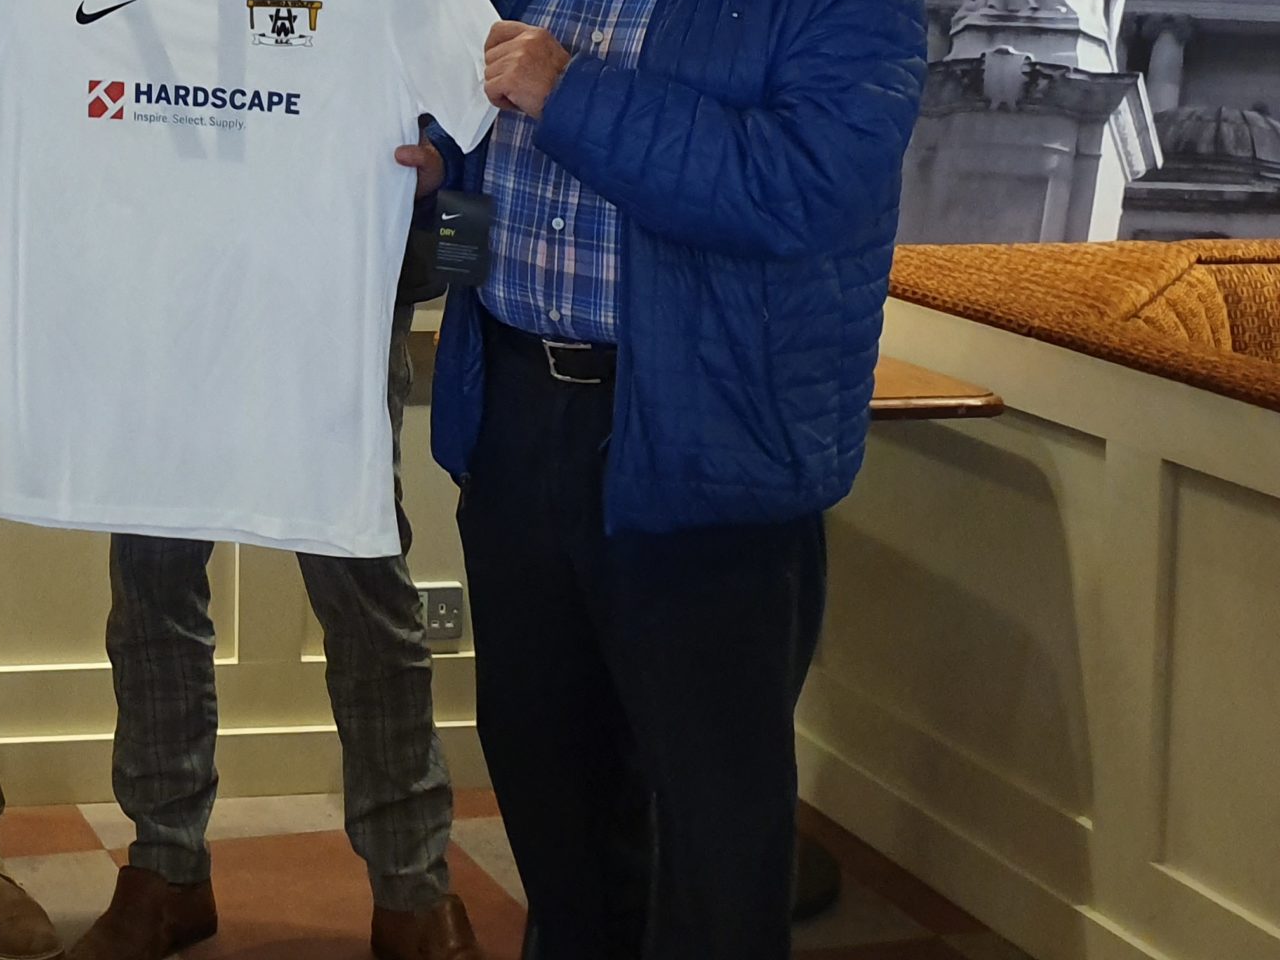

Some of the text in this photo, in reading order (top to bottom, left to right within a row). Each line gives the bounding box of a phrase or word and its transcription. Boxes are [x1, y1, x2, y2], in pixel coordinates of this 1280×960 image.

[134, 82, 301, 115] HARDSCAPE
[173, 113, 206, 126] Select.
[209, 116, 246, 131] Supply.
